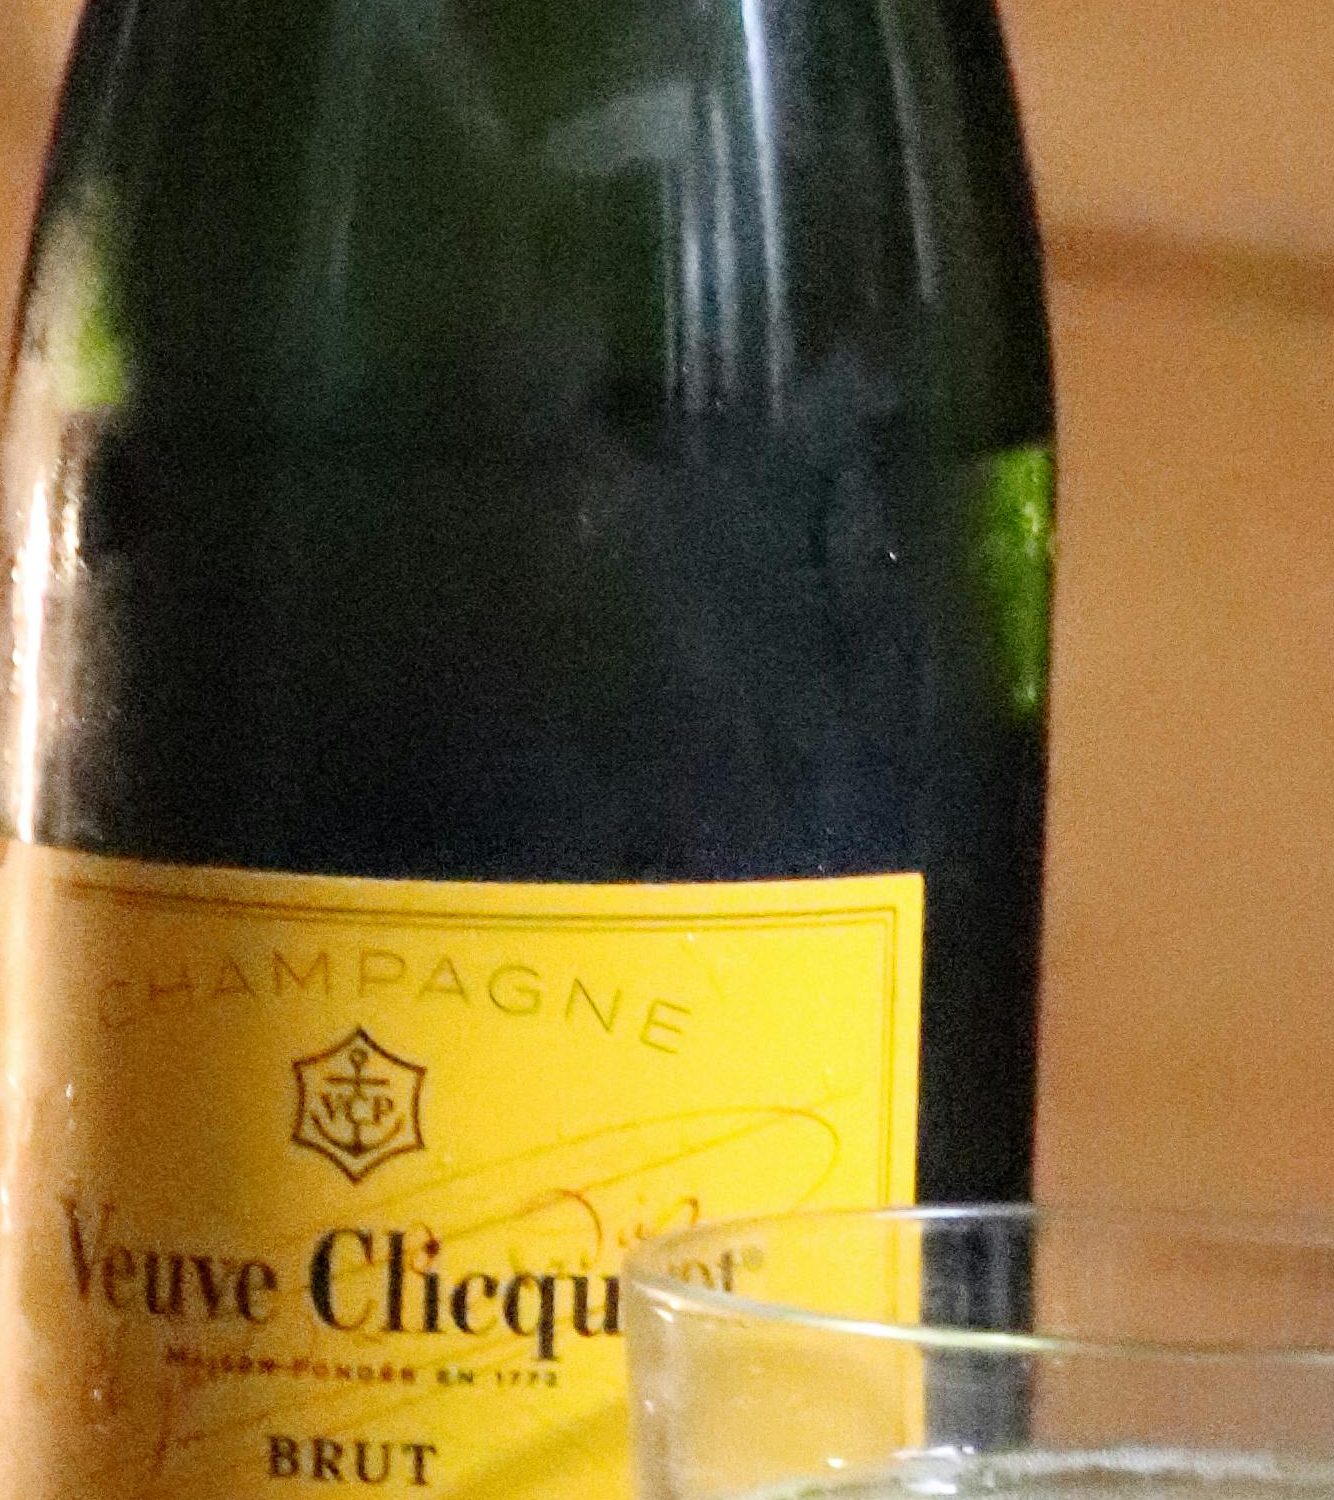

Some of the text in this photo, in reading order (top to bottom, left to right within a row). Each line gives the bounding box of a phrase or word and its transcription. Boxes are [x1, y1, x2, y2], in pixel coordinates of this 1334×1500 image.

[99, 948, 693, 1056] CHAMPAGNE
[63, 1202, 279, 1326] Veuve
[494, 1368, 558, 1388] 1772
[267, 1433, 439, 1487] BRUT
